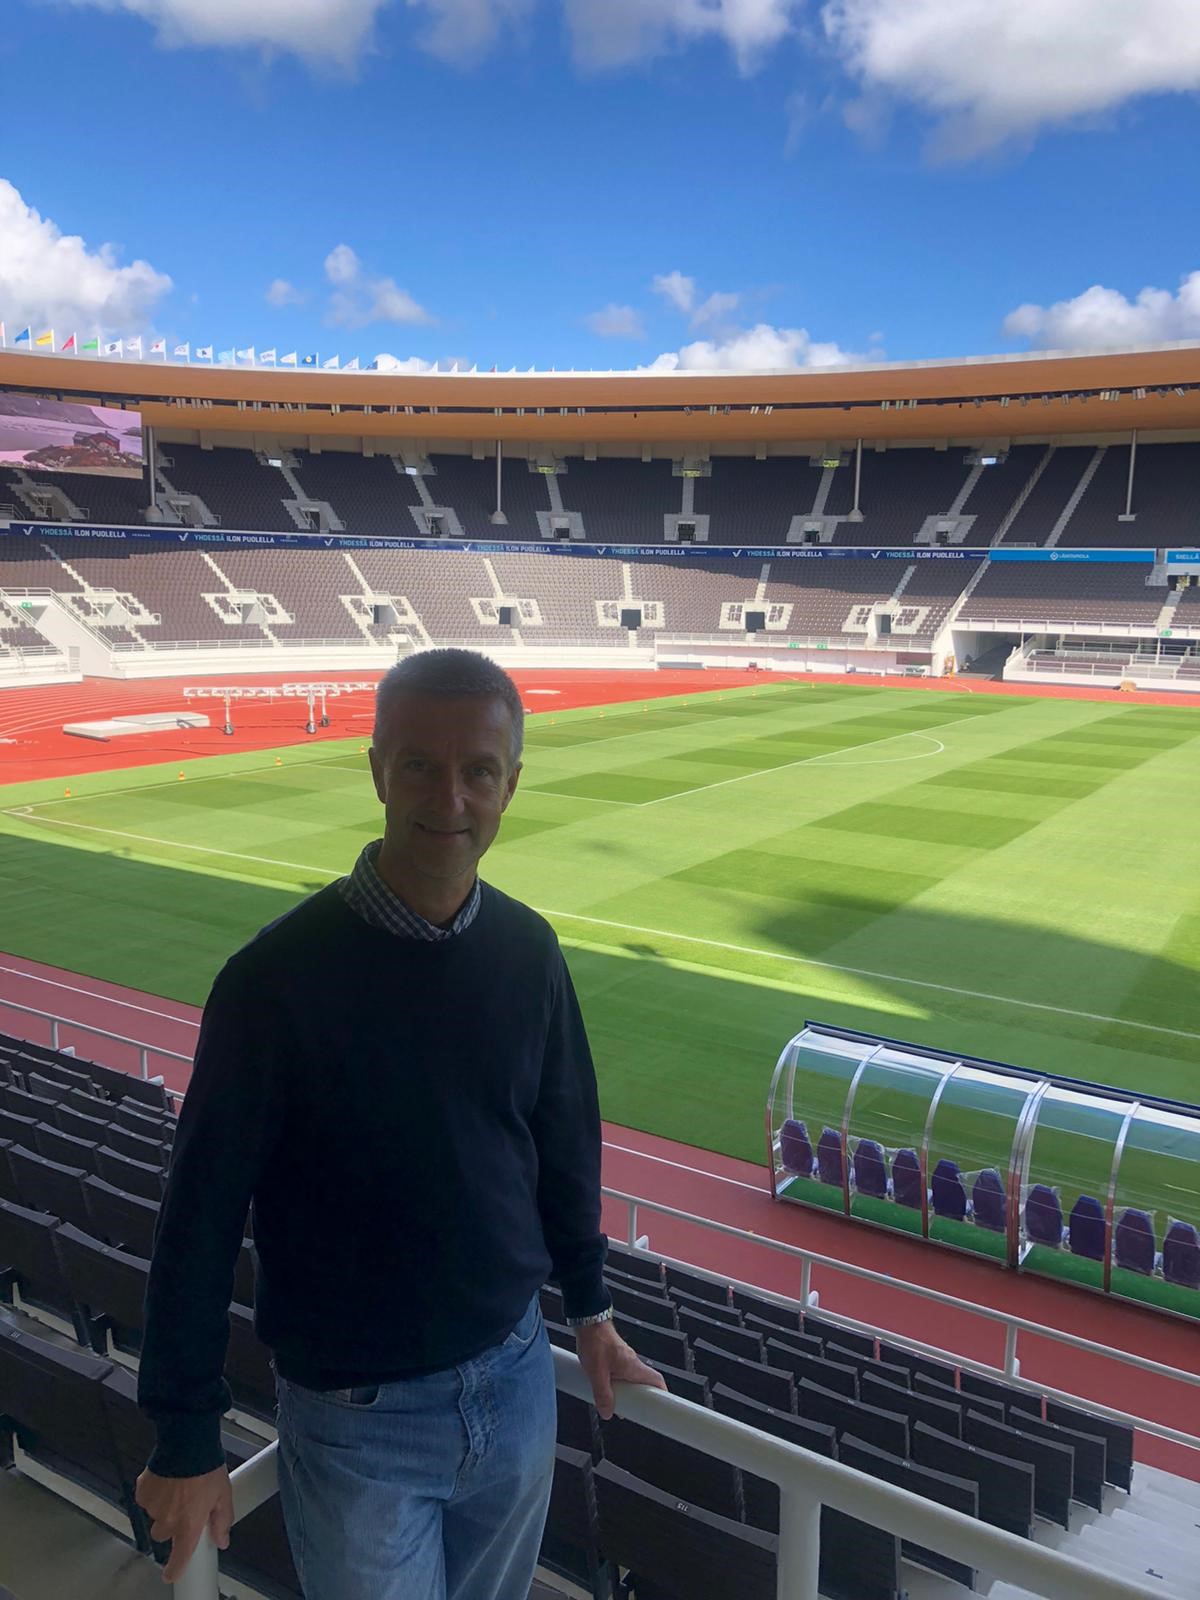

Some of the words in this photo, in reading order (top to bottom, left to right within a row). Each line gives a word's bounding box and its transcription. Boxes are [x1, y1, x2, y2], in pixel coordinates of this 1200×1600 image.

[40, 527, 73, 536] YHDESSÄ
[74, 529, 90, 537] ILON
[91, 530, 126, 538] PUOLELLA
